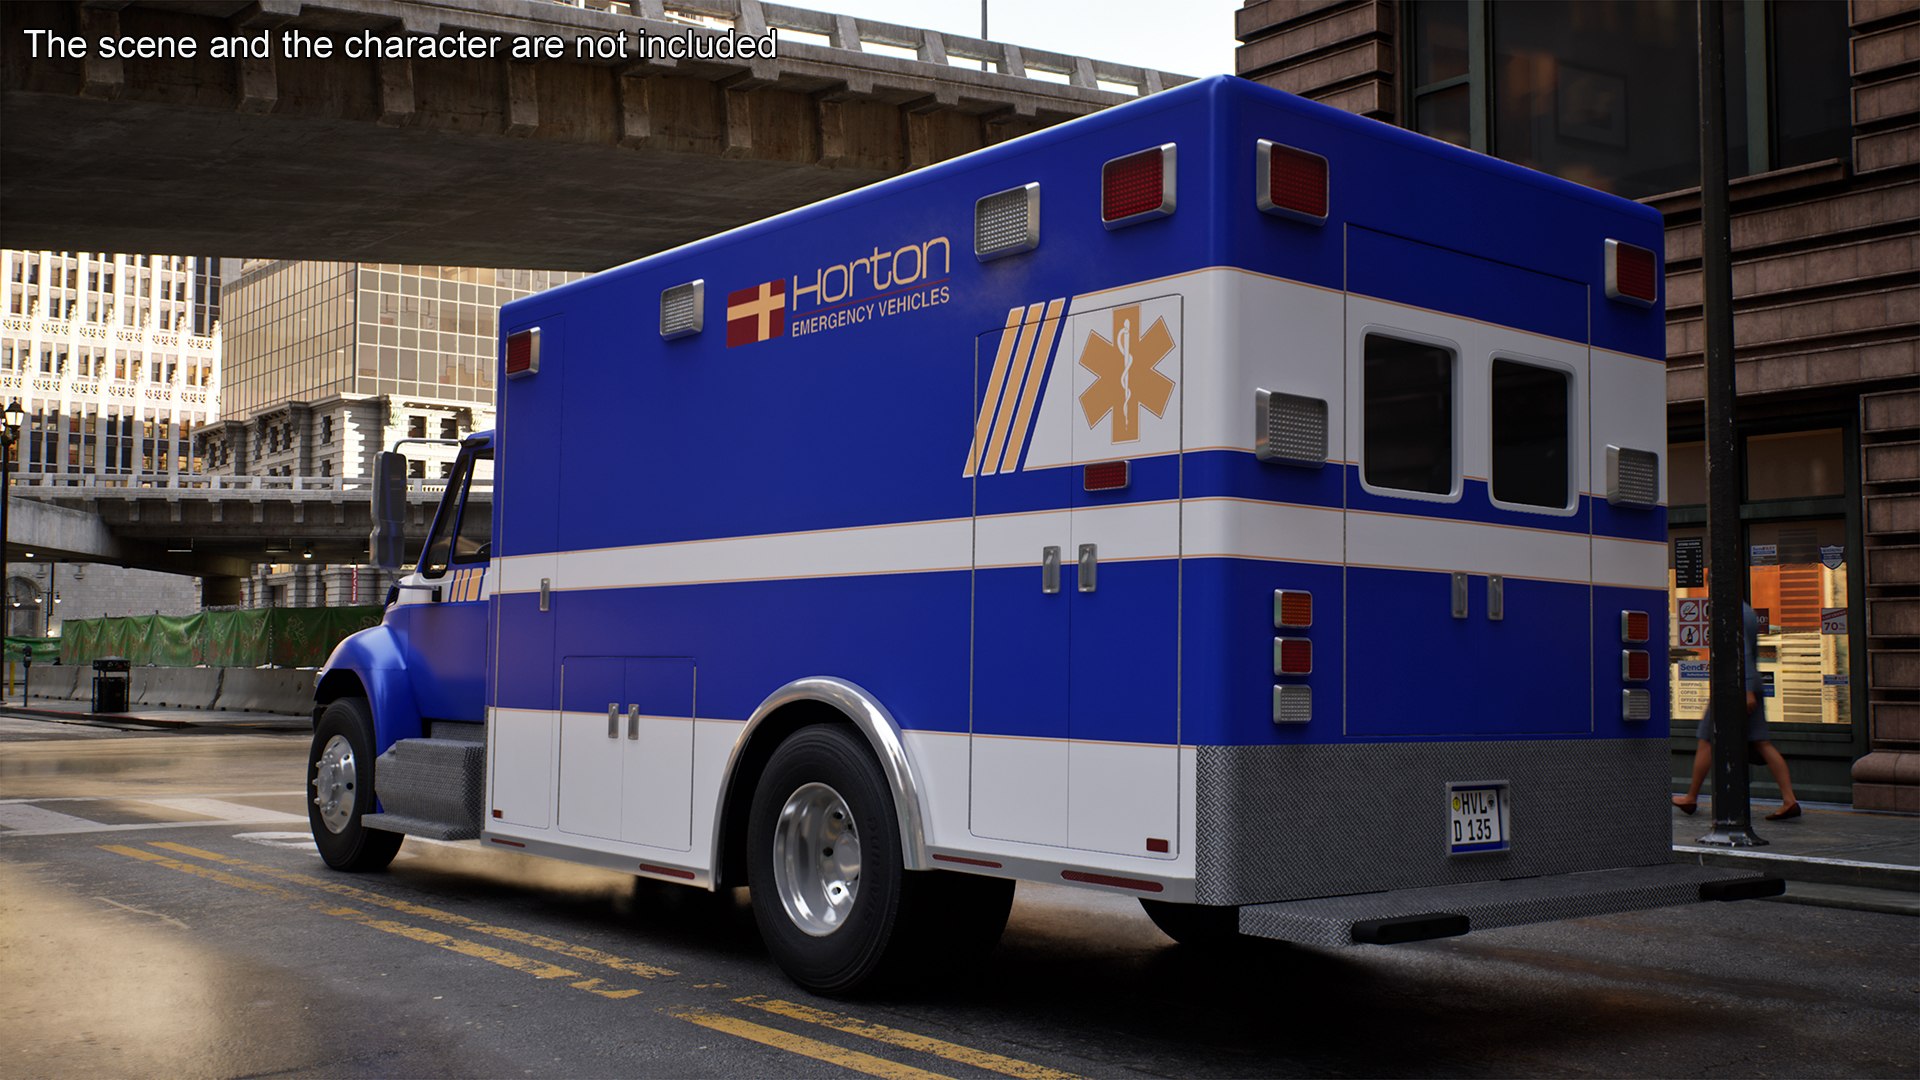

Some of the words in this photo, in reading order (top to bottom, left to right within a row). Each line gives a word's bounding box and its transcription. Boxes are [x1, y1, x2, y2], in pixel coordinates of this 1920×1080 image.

[792, 236, 951, 312] Horton
[792, 304, 875, 338] EMERGENCY
[878, 286, 950, 318] VEHICLES
[1462, 792, 1488, 815] HVL
[1454, 820, 1463, 842] D
[1467, 818, 1492, 841] 135
